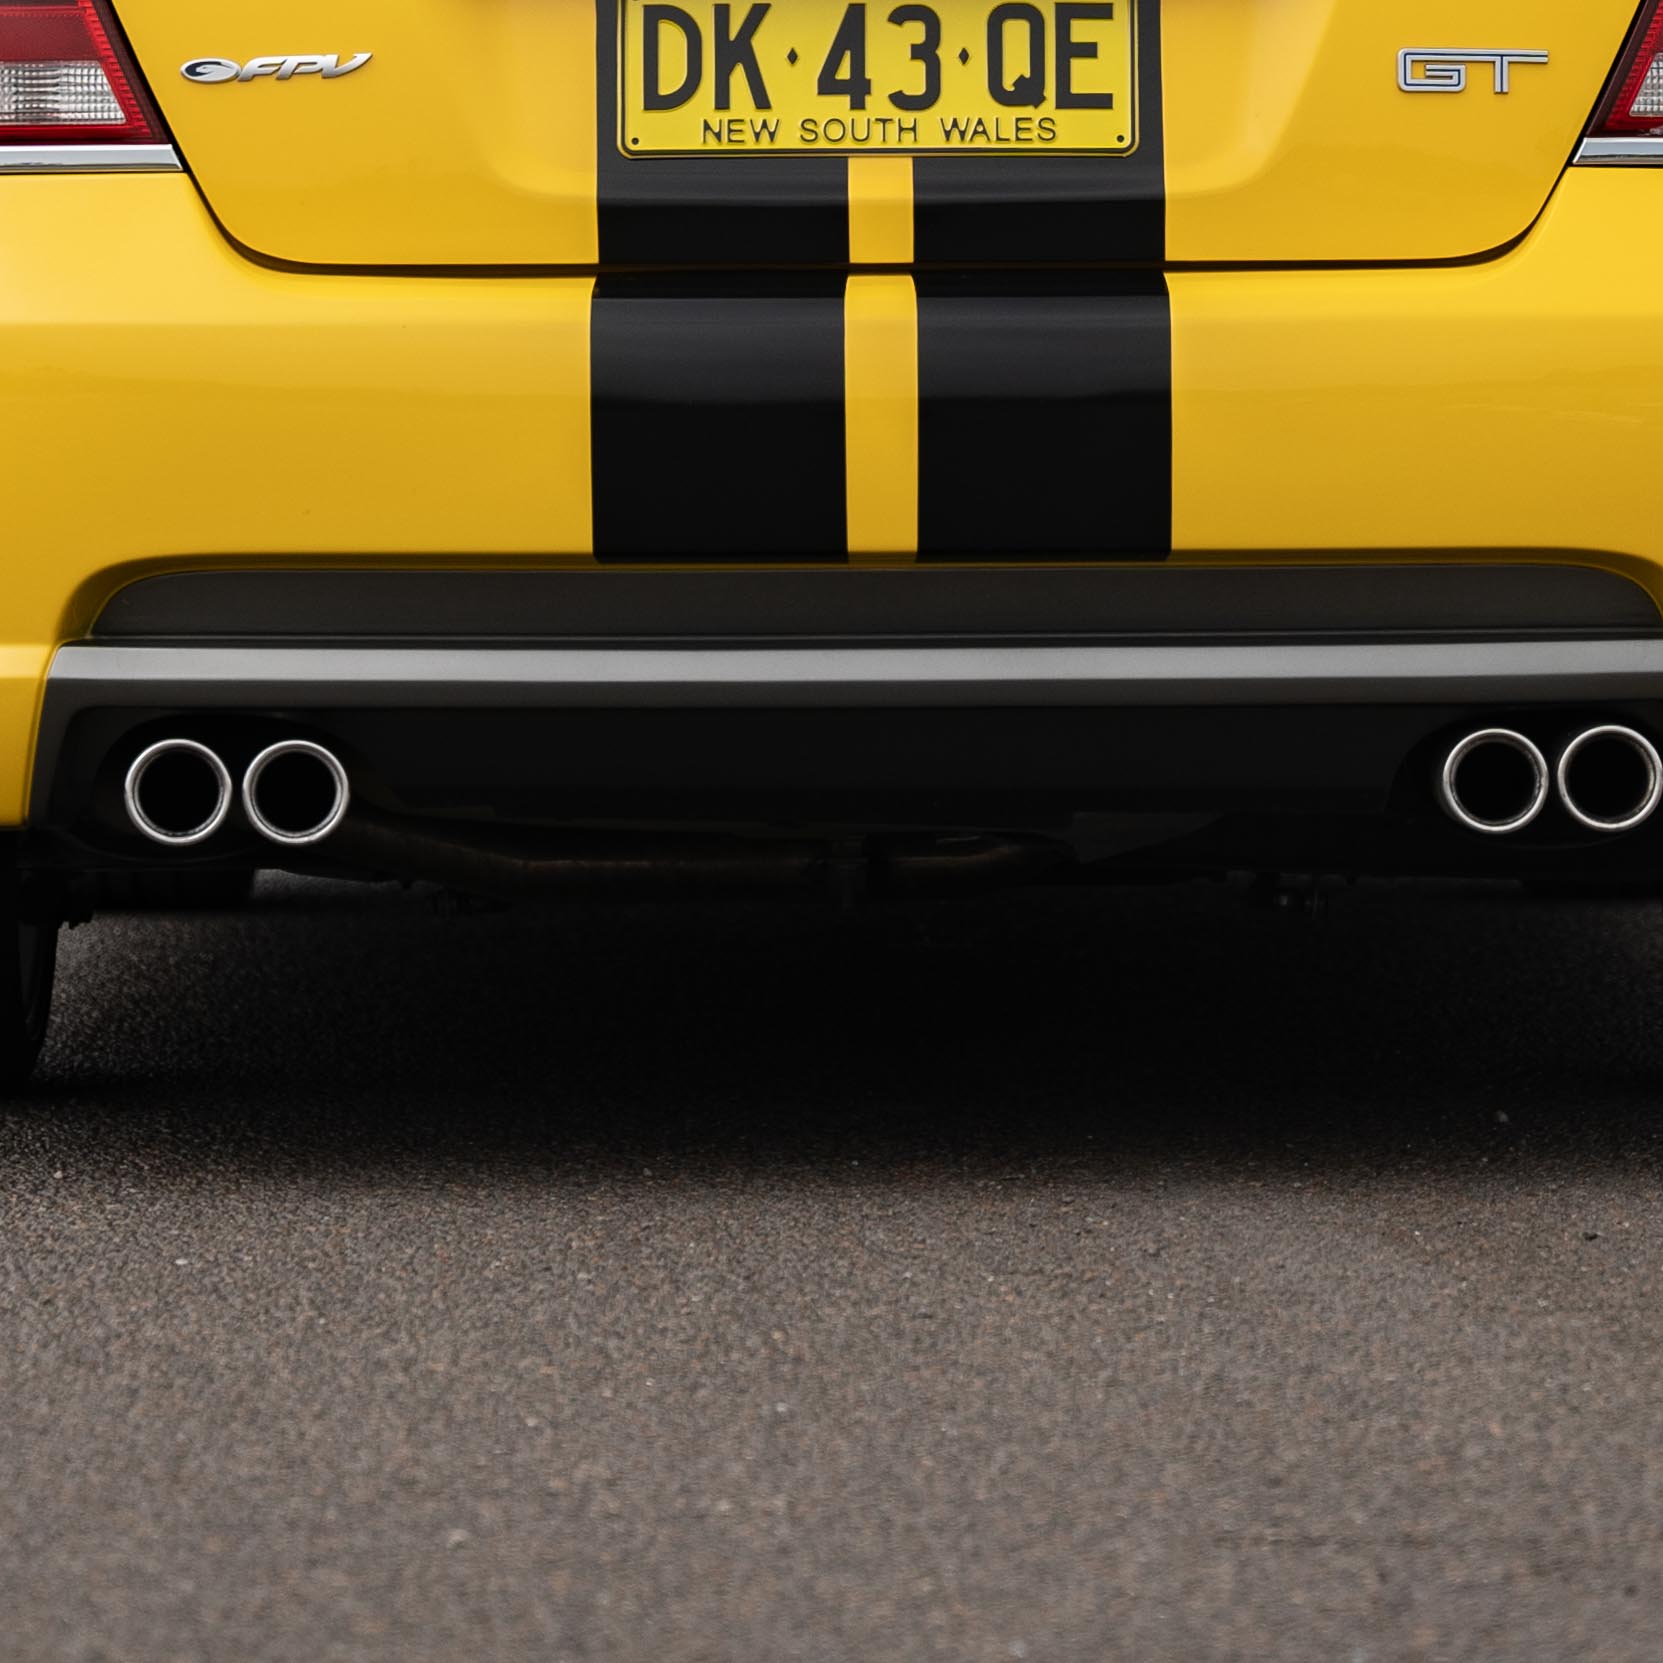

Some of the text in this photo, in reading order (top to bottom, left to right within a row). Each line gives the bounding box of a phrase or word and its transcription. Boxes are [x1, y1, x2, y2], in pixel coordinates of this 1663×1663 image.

[238, 52, 373, 82] FPV
[1397, 48, 1549, 94] GT
[702, 117, 1057, 144] NEW SOUTH WALES
